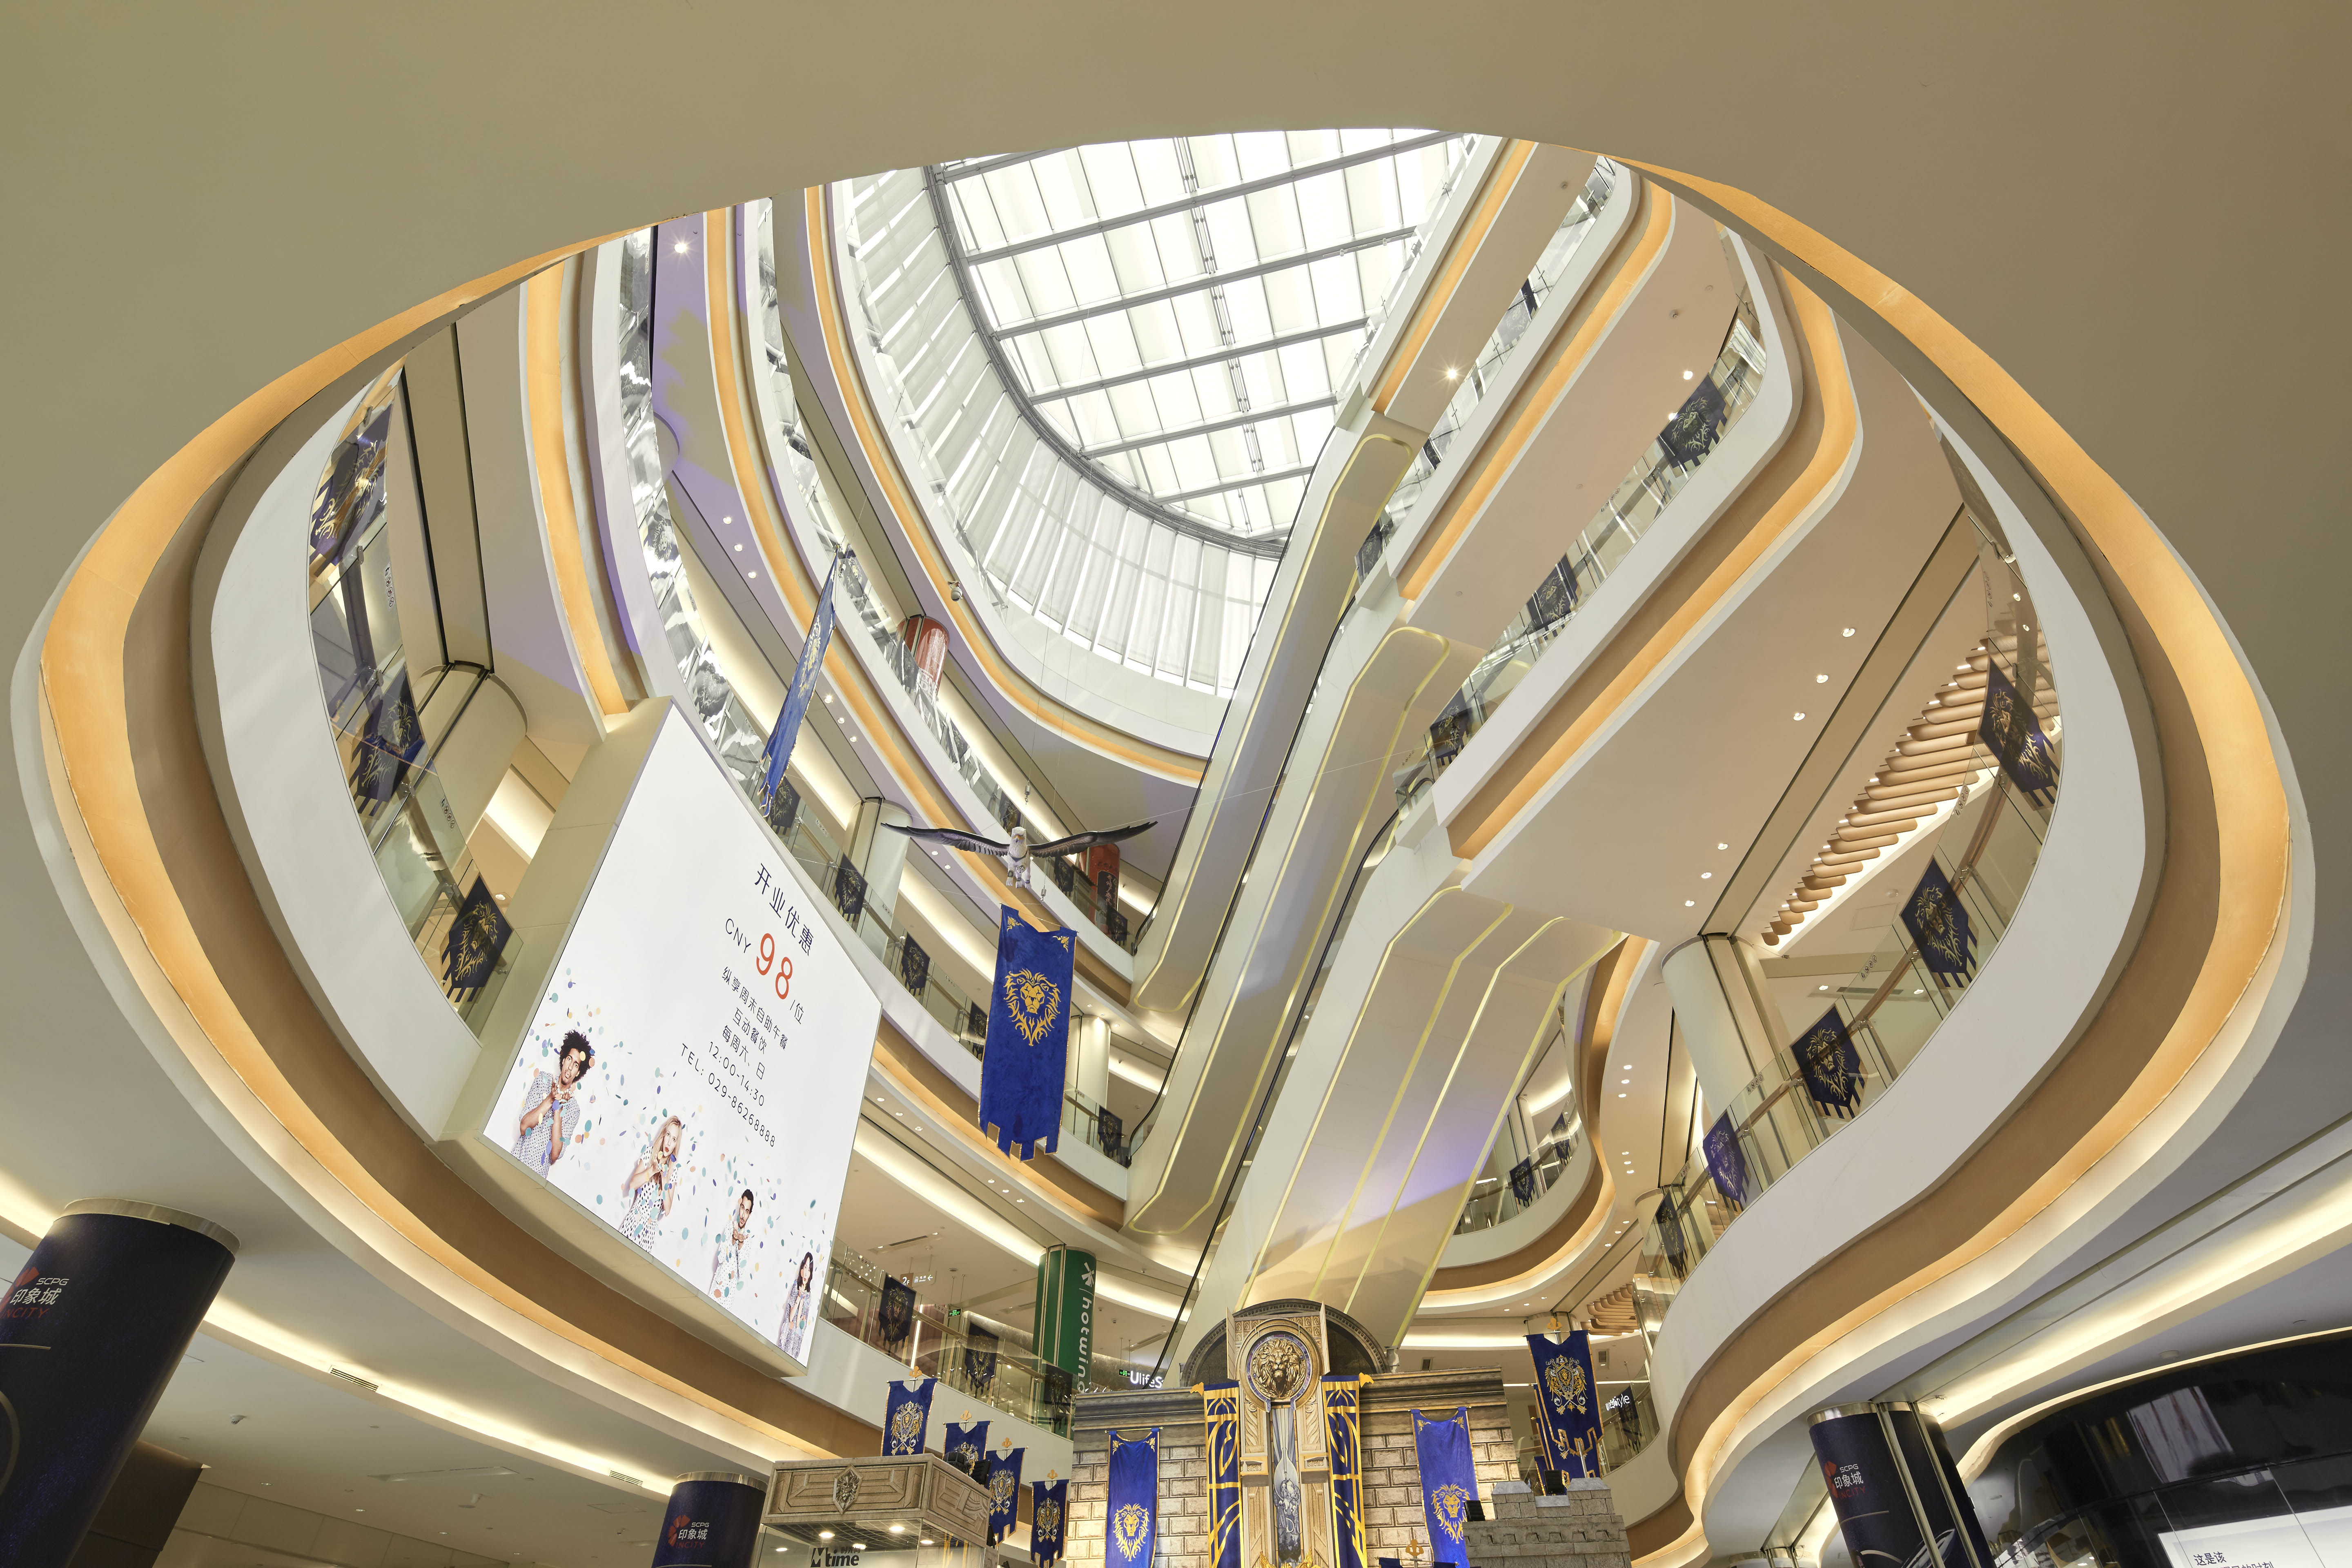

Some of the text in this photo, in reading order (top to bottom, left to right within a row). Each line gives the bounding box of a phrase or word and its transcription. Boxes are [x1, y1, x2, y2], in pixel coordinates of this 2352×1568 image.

[755, 863, 813, 956] 开业优惠
[725, 918, 804, 1025] CNY 98 /位
[722, 967, 788, 1050] 纵享周末自助午餐
[733, 1007, 767, 1054] 互动餐饮
[709, 1042, 764, 1106] 12:00-14:30
[722, 1025, 765, 1080] 每周六、日
[681, 1043, 775, 1147] TEL: 029-86268888
[9, 1287, 62, 1305] 印象城
[1130, 1370, 1164, 1388] UlifeS
[1834, 1471, 1864, 1489] 印象城
[1840, 1464, 1859, 1473] SCPG
[678, 1528, 708, 1540] 印象城
[2193, 1551, 2227, 1566] 这是该
